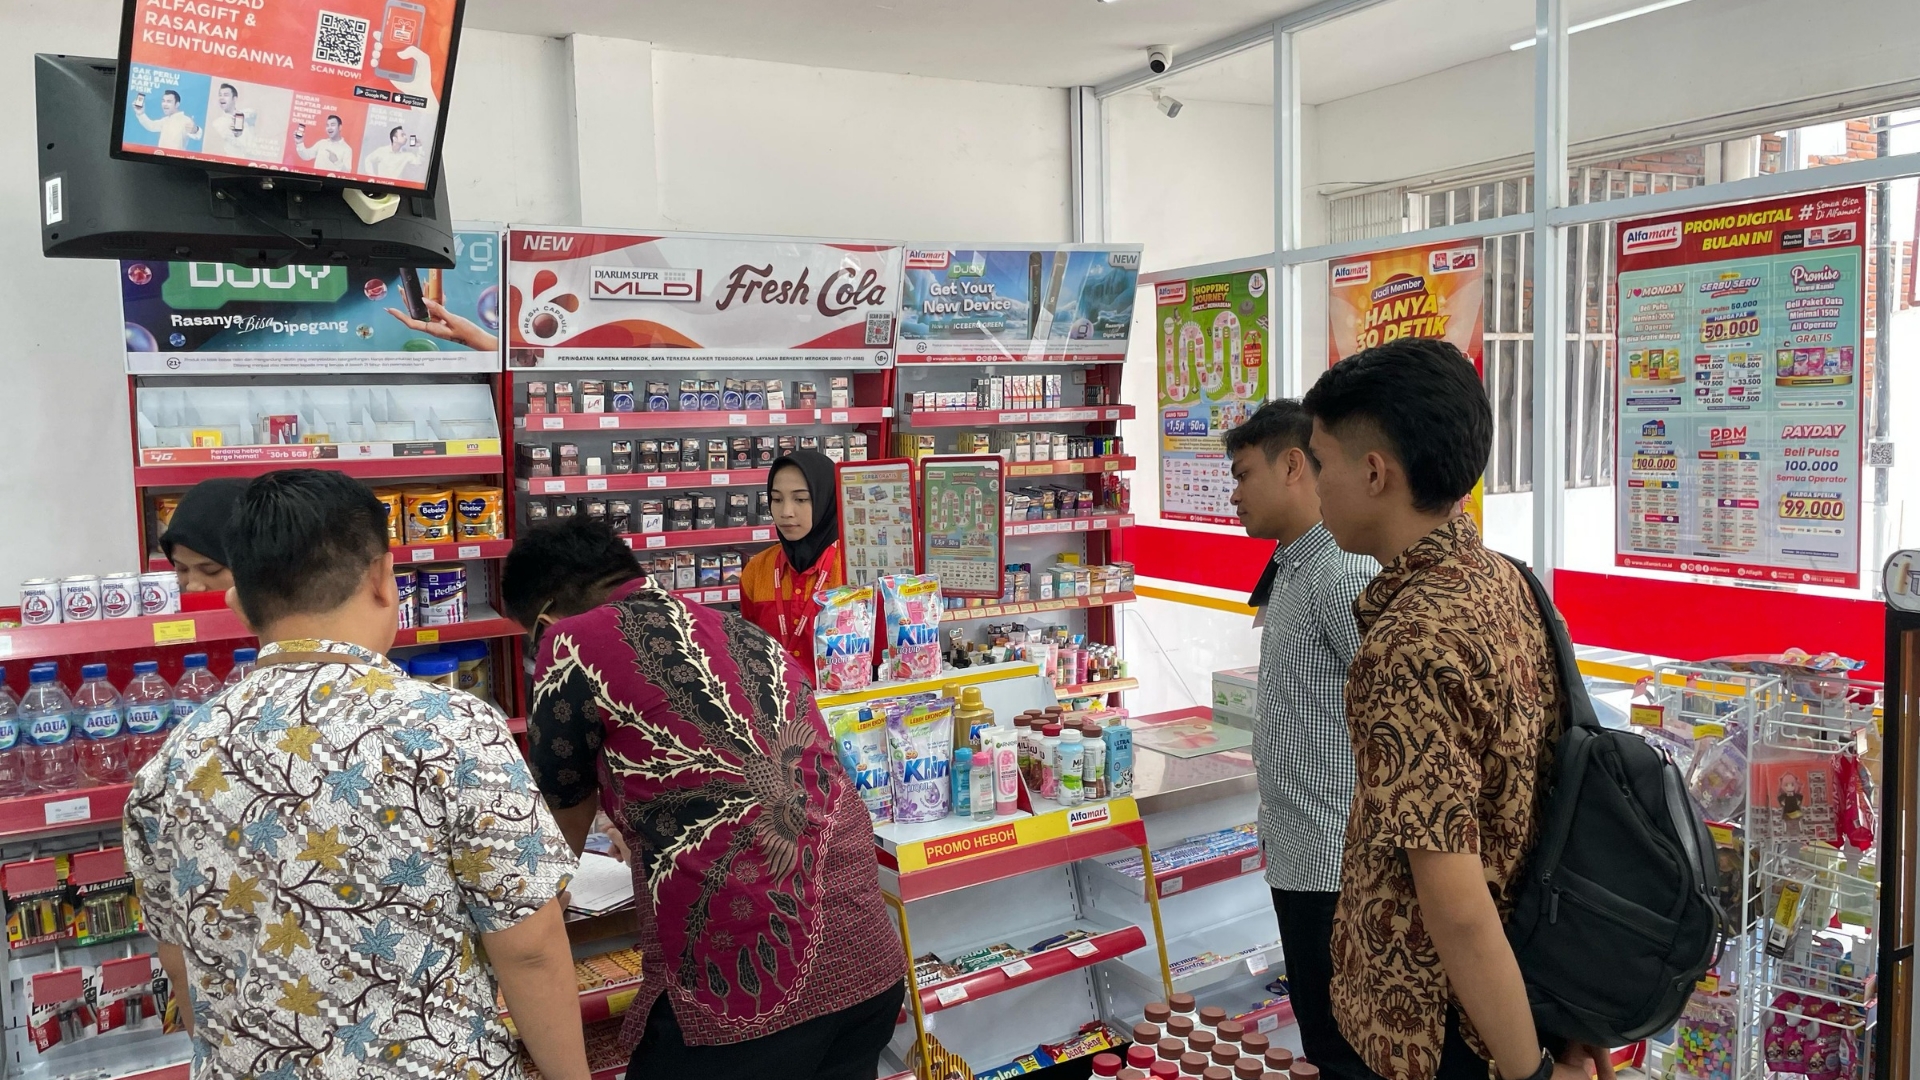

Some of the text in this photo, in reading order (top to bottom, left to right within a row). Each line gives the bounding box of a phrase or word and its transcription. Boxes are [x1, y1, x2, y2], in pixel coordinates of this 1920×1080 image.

[147, 0, 240, 22] ALFAGIFT
[244, 13, 256, 26] &
[145, 11, 238, 41] RASAKAN
[143, 29, 294, 69] KEUNTUNGANNYA
[132, 67, 180, 80] GAK PERLU
[132, 73, 152, 81] LAGI
[310, 64, 362, 80] SCAN NOW!
[131, 79, 160, 89] KARTU
[131, 85, 152, 94] FISIK
[322, 104, 338, 112] JADI
[402, 98, 411, 106] App
[1816, 198, 1860, 210] Semua Bisa
[1798, 204, 1814, 220] #
[1816, 206, 1862, 220] Di Alfamart
[1684, 208, 1794, 234] PROMO DIGITAL
[1627, 226, 1678, 243] Alfamart
[1702, 230, 1773, 250] BULAN INI
[523, 235, 574, 251] NEW
[1782, 238, 1802, 246] Member
[908, 250, 944, 260] Alfamart
[1113, 255, 1138, 264] NEW
[595, 270, 658, 280] DJARUM SUPER
[953, 266, 984, 274] DJOY
[1334, 265, 1368, 278] Alfamart
[1792, 266, 1840, 285] Promise
[594, 281, 693, 296] MLD
[715, 264, 886, 317] Fresh Cola
[930, 282, 994, 297] Get Your
[1159, 286, 1184, 296] Alfamart
[1192, 284, 1230, 294] SHOPPING
[1374, 280, 1422, 300] Jadi Member
[1642, 283, 1686, 296] MONDAY
[1700, 278, 1760, 292] SERBU SERU
[1194, 293, 1228, 304] JOURNEY
[1731, 300, 1758, 310] 50.000
[1786, 301, 1800, 309] Beli
[924, 298, 1011, 314] New Device
[1364, 295, 1438, 330] HANYA
[525, 306, 566, 334] FRESH CAPSULE
[1714, 313, 1734, 322] HARGA
[1790, 308, 1840, 320] Minimal 150K
[171, 314, 348, 336] Rasanya Bisa Dipegang
[1644, 323, 1672, 332] Operator
[1704, 318, 1759, 340] 50.000
[1792, 321, 1837, 331] All Operator
[1356, 315, 1450, 352] 30 DETIK
[1640, 334, 1658, 342] Gratis
[1658, 333, 1680, 342] Minyak
[1796, 334, 1832, 343] GRATIS
[1711, 426, 1747, 440] PDM
[1782, 424, 1846, 439] PAYDAY
[1784, 448, 1840, 457] Beli Pulsa
[1637, 458, 1676, 468] 100.000
[1786, 460, 1838, 472] 100.000
[1776, 474, 1848, 484] Semua Operator
[422, 506, 446, 514] Bebelac
[460, 504, 482, 512] Bebelac
[1784, 499, 1844, 517] 99.000
[1709, 566, 1730, 574] Alfamart
[897, 624, 938, 646] Klin
[826, 634, 870, 656] Klin
[86, 714, 118, 728] AQUA
[128, 711, 158, 723] AQUA
[910, 716, 924, 724] LEBIH
[34, 720, 67, 734] AQUA
[858, 721, 872, 730] LEBIH
[904, 756, 949, 783] Klin
[856, 768, 890, 791] Klin
[1070, 807, 1108, 822] Alfamart
[926, 828, 1016, 859] PROMO HEBOH
[76, 876, 134, 896] Alkaline
[1064, 1035, 1102, 1058] beng-beng
